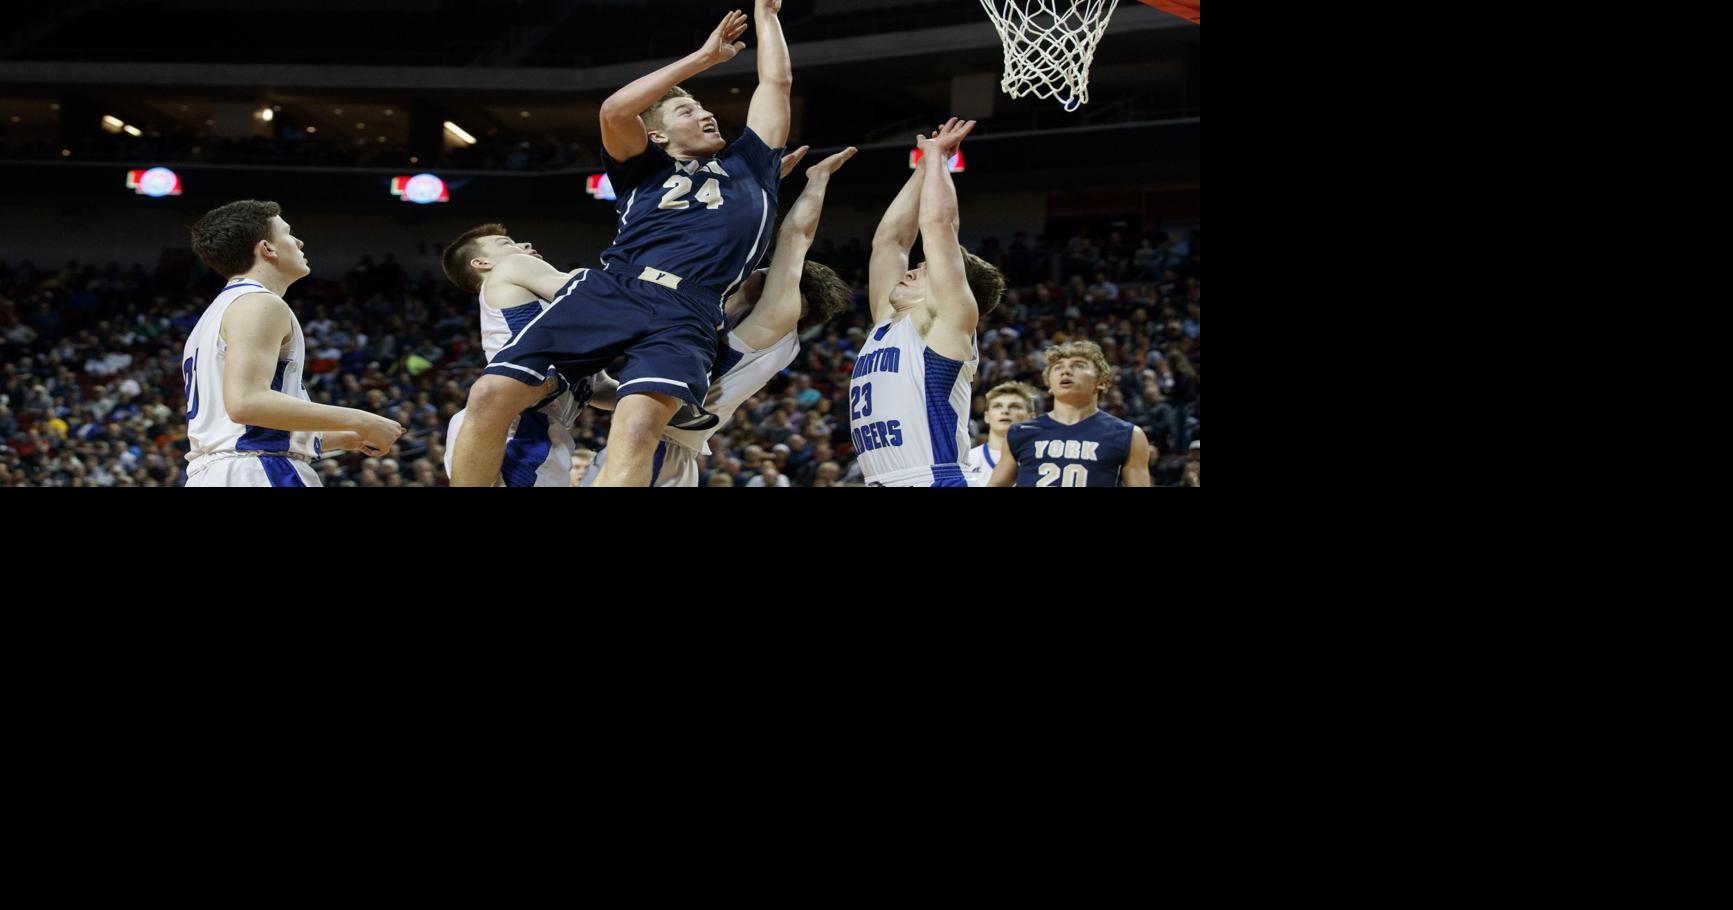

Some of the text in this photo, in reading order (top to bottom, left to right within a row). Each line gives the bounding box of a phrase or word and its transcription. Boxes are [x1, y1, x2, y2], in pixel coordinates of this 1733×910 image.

[658, 175, 724, 210] 24
[851, 381, 873, 421] 23
[1034, 439, 1100, 462] YORK
[1035, 462, 1089, 487] 20
